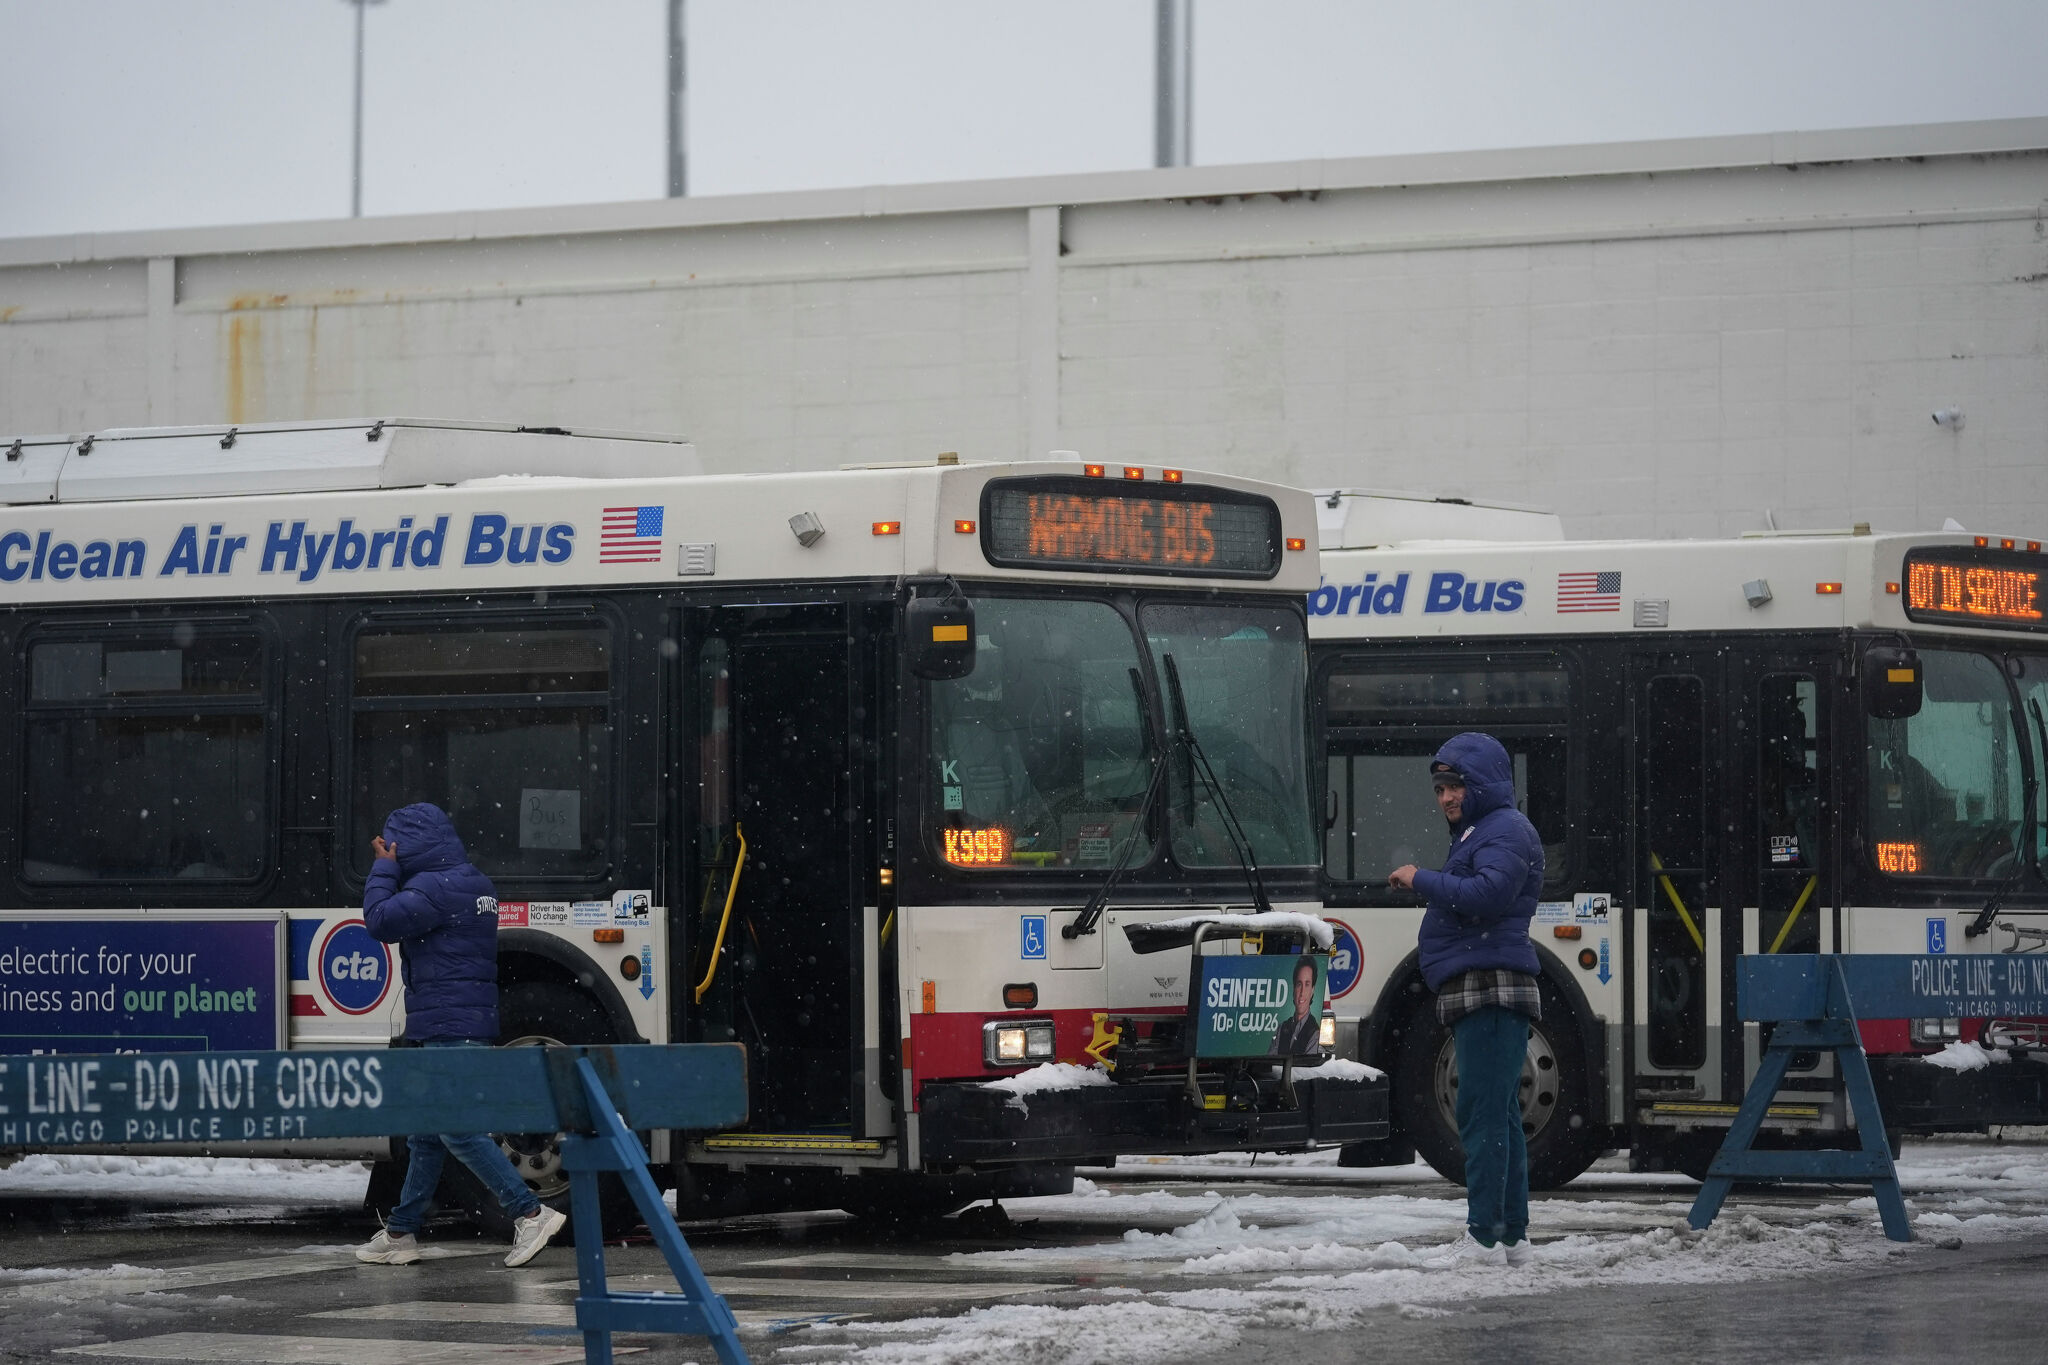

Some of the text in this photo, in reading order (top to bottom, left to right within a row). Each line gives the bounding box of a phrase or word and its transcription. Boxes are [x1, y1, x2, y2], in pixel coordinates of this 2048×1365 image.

[1162, 500, 1215, 563] BUS
[0, 513, 576, 583] Clean Air Hybrid Bus
[1307, 570, 1525, 617] brid Bus
[1941, 566, 1961, 611] IN
[1966, 568, 2039, 617] SERVICE
[942, 760, 960, 783] K
[1881, 750, 1893, 770] K
[528, 796, 566, 825] Bus
[944, 829, 1003, 862] K999
[1878, 843, 1917, 872] K676
[476, 895, 498, 915] STATES
[498, 904, 524, 912] act fare
[498, 913, 519, 921] quired
[530, 904, 565, 912] Driver has
[530, 912, 568, 921] NO change
[614, 919, 638, 927] Kneeling
[0, 946, 197, 980] electric for your
[331, 951, 379, 981] cta
[1912, 959, 1960, 996] POLICE
[2032, 959, 2048, 995] NO
[0, 983, 257, 1018] iness and our planet
[1207, 977, 1288, 1008] SEINFELD
[1949, 1001, 2043, 1016] CHICAGO POLICE
[198, 1059, 259, 1110] NOT
[276, 1056, 384, 1110] CROSS
[3, 1115, 307, 1144] HICAGO POLICE DEPT
